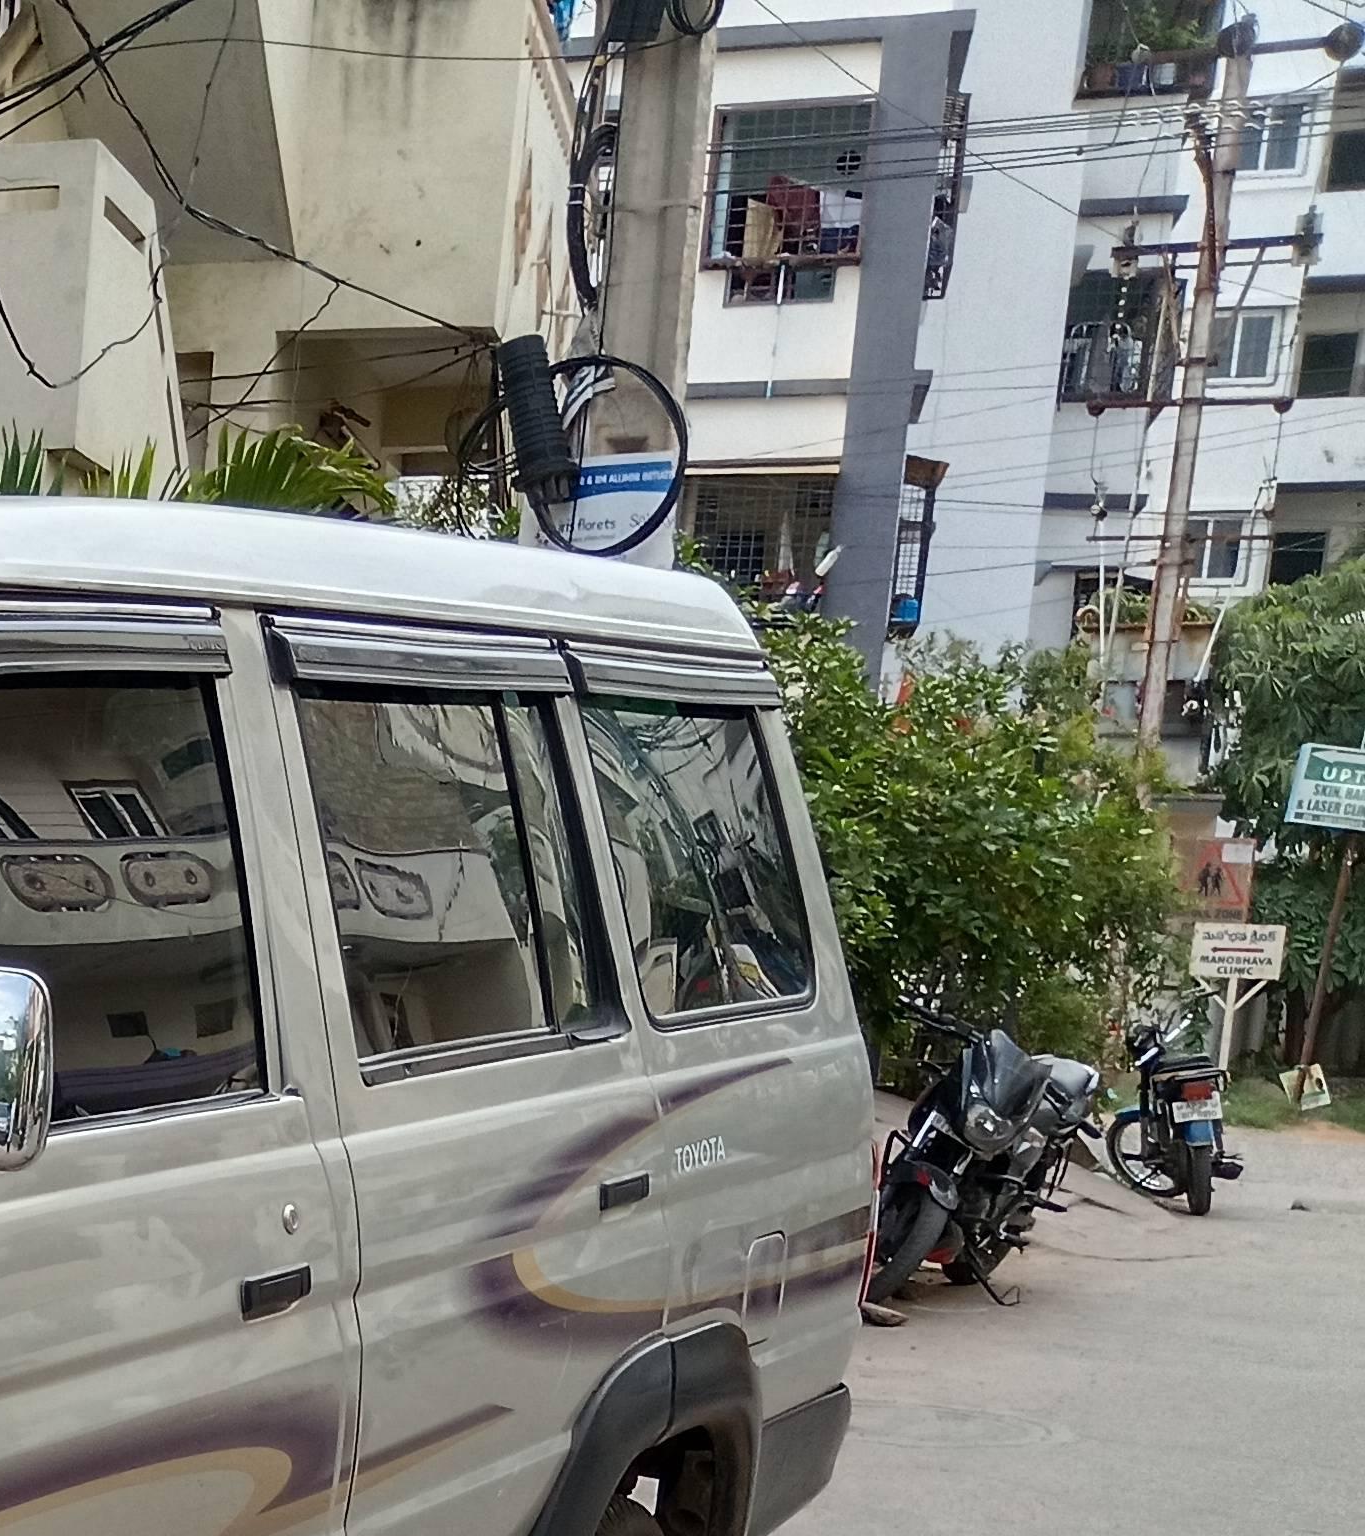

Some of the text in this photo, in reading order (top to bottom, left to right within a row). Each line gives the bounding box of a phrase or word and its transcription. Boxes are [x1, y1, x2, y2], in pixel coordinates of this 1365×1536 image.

[1323, 766, 1365, 783] UPT
[1307, 800, 1342, 814] LASER
[1200, 955, 1273, 966] MANOBHAVA
[1217, 966, 1253, 975] CLINIC
[675, 1136, 725, 1174] TOYOTA
